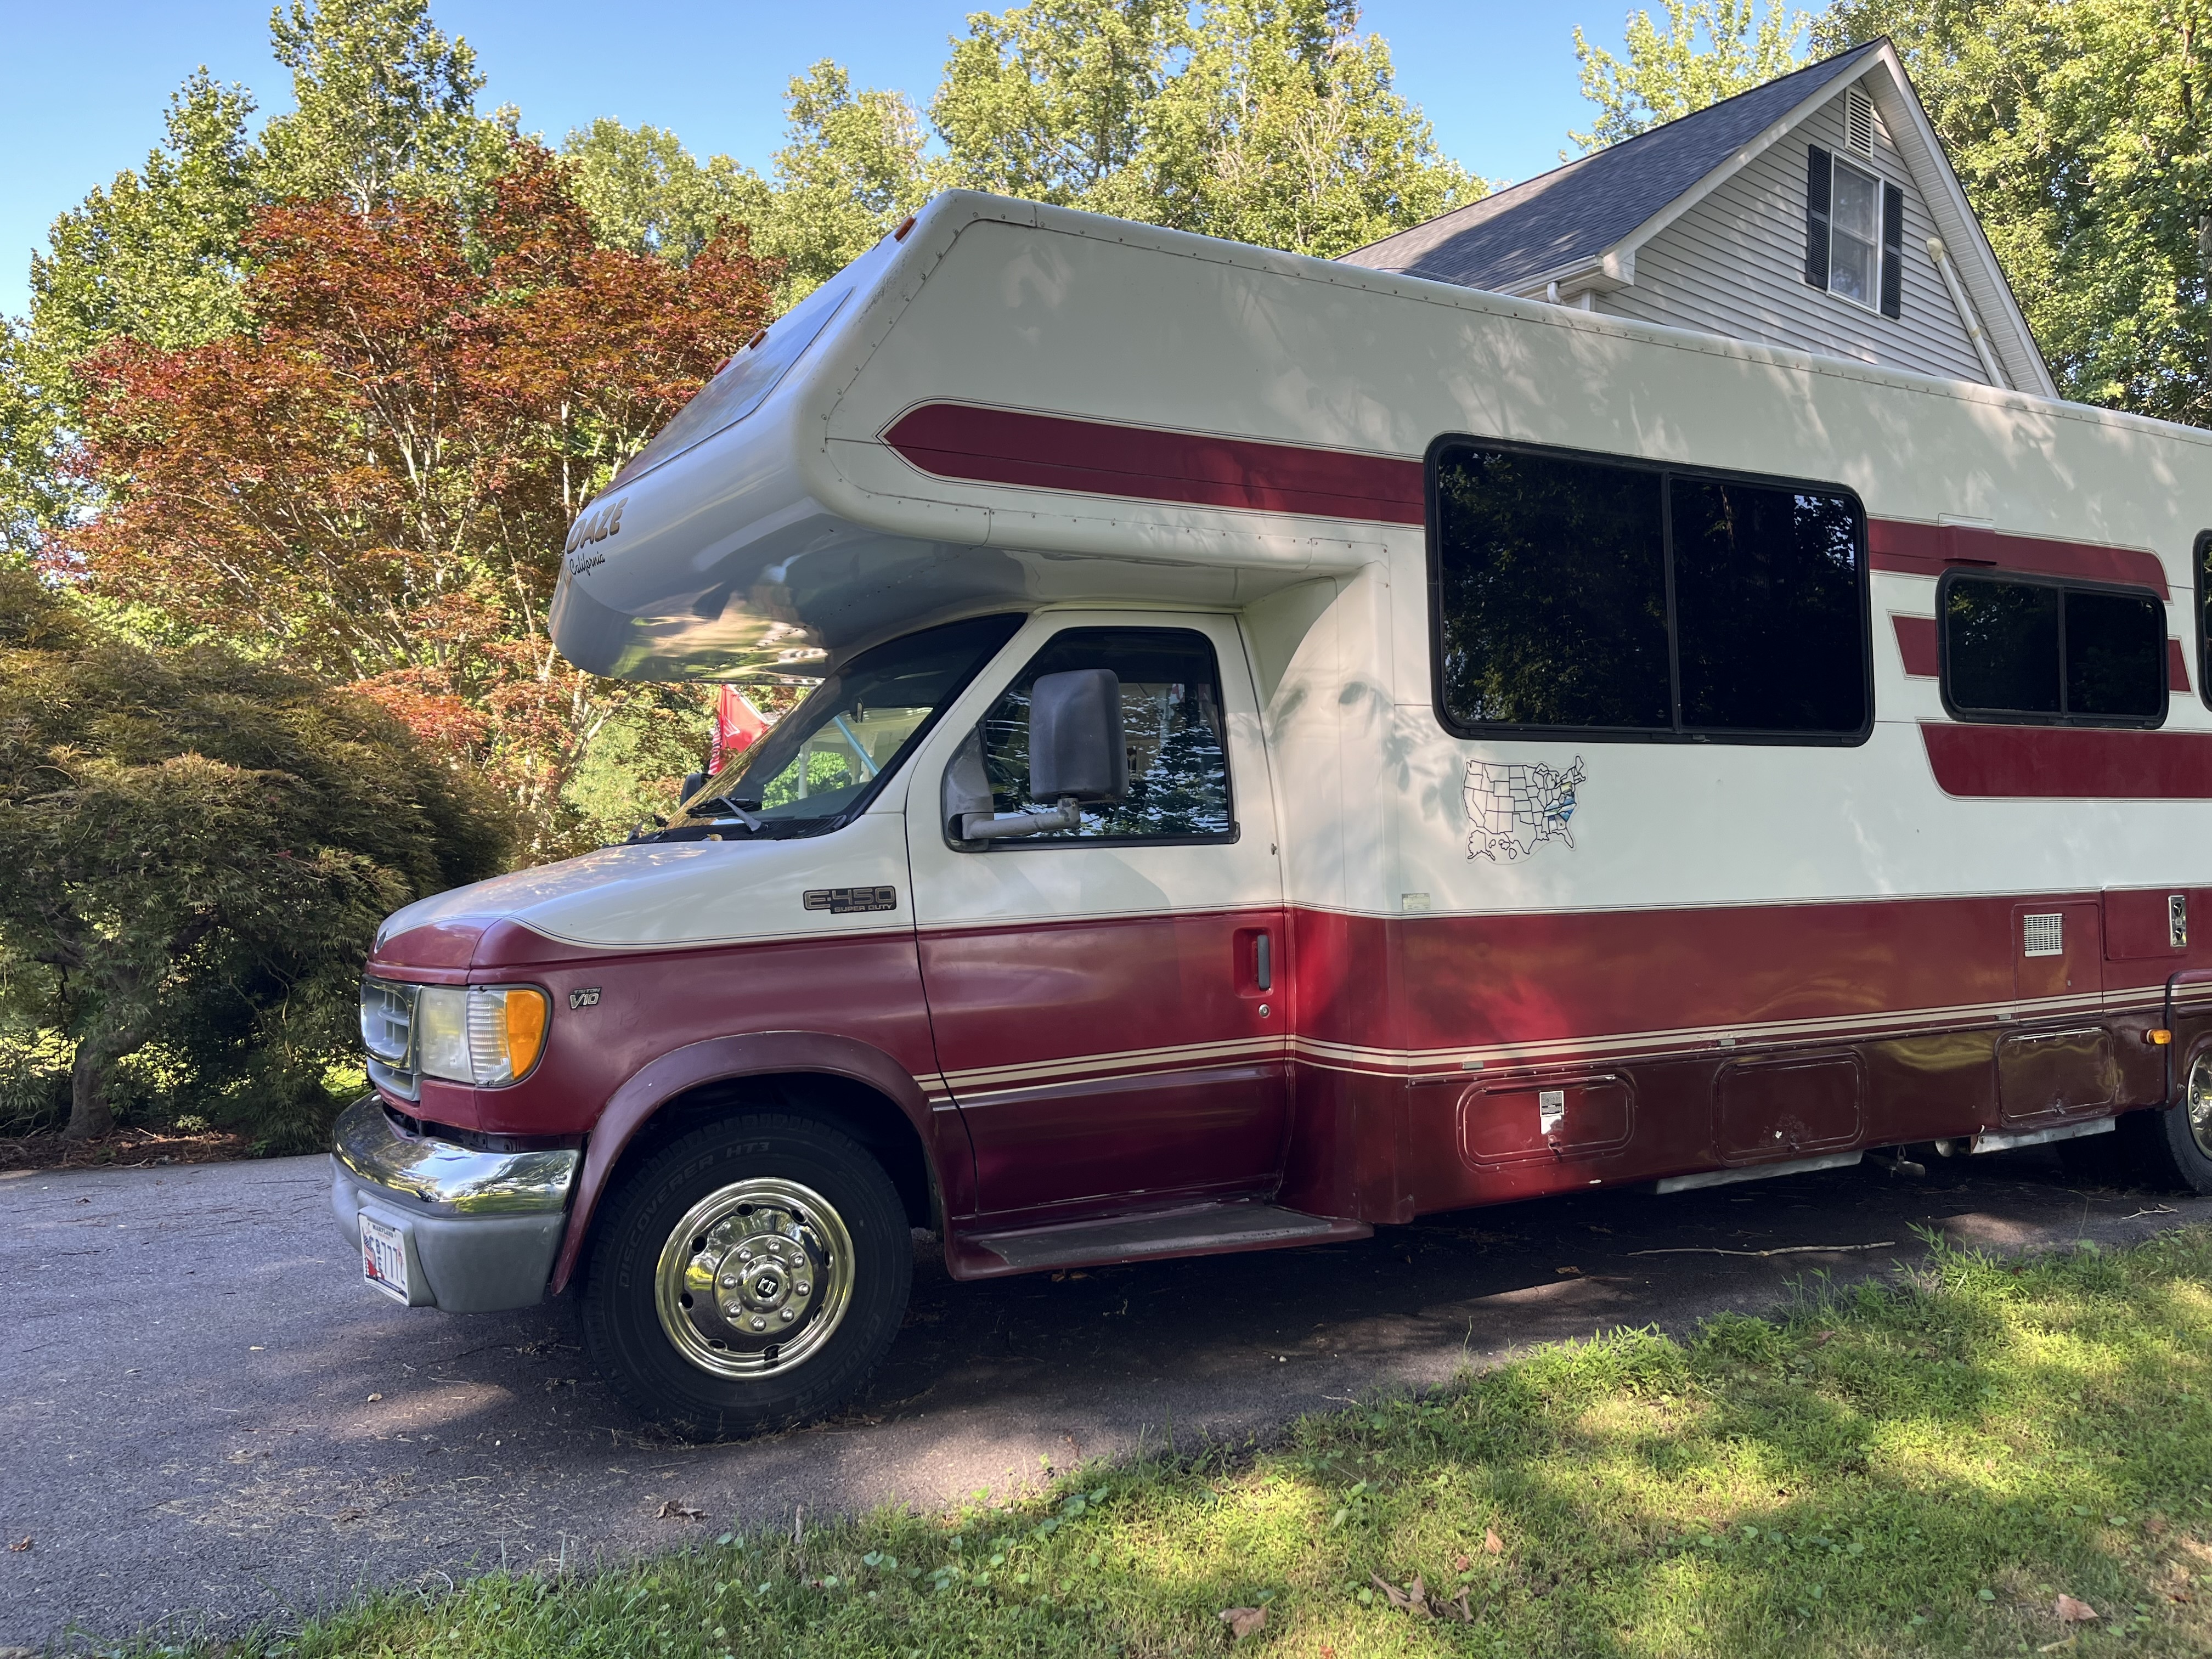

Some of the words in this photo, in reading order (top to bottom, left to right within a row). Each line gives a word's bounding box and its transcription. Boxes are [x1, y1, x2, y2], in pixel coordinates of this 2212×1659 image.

[567, 497, 629, 554] DAZE
[569, 551, 605, 576] California
[569, 993, 599, 1009] V10
[373, 1224, 393, 1238] MARYLAND
[619, 1155, 714, 1289] DISCOVERER
[726, 1141, 771, 1159] HT3
[795, 1313, 881, 1408] COOPER
